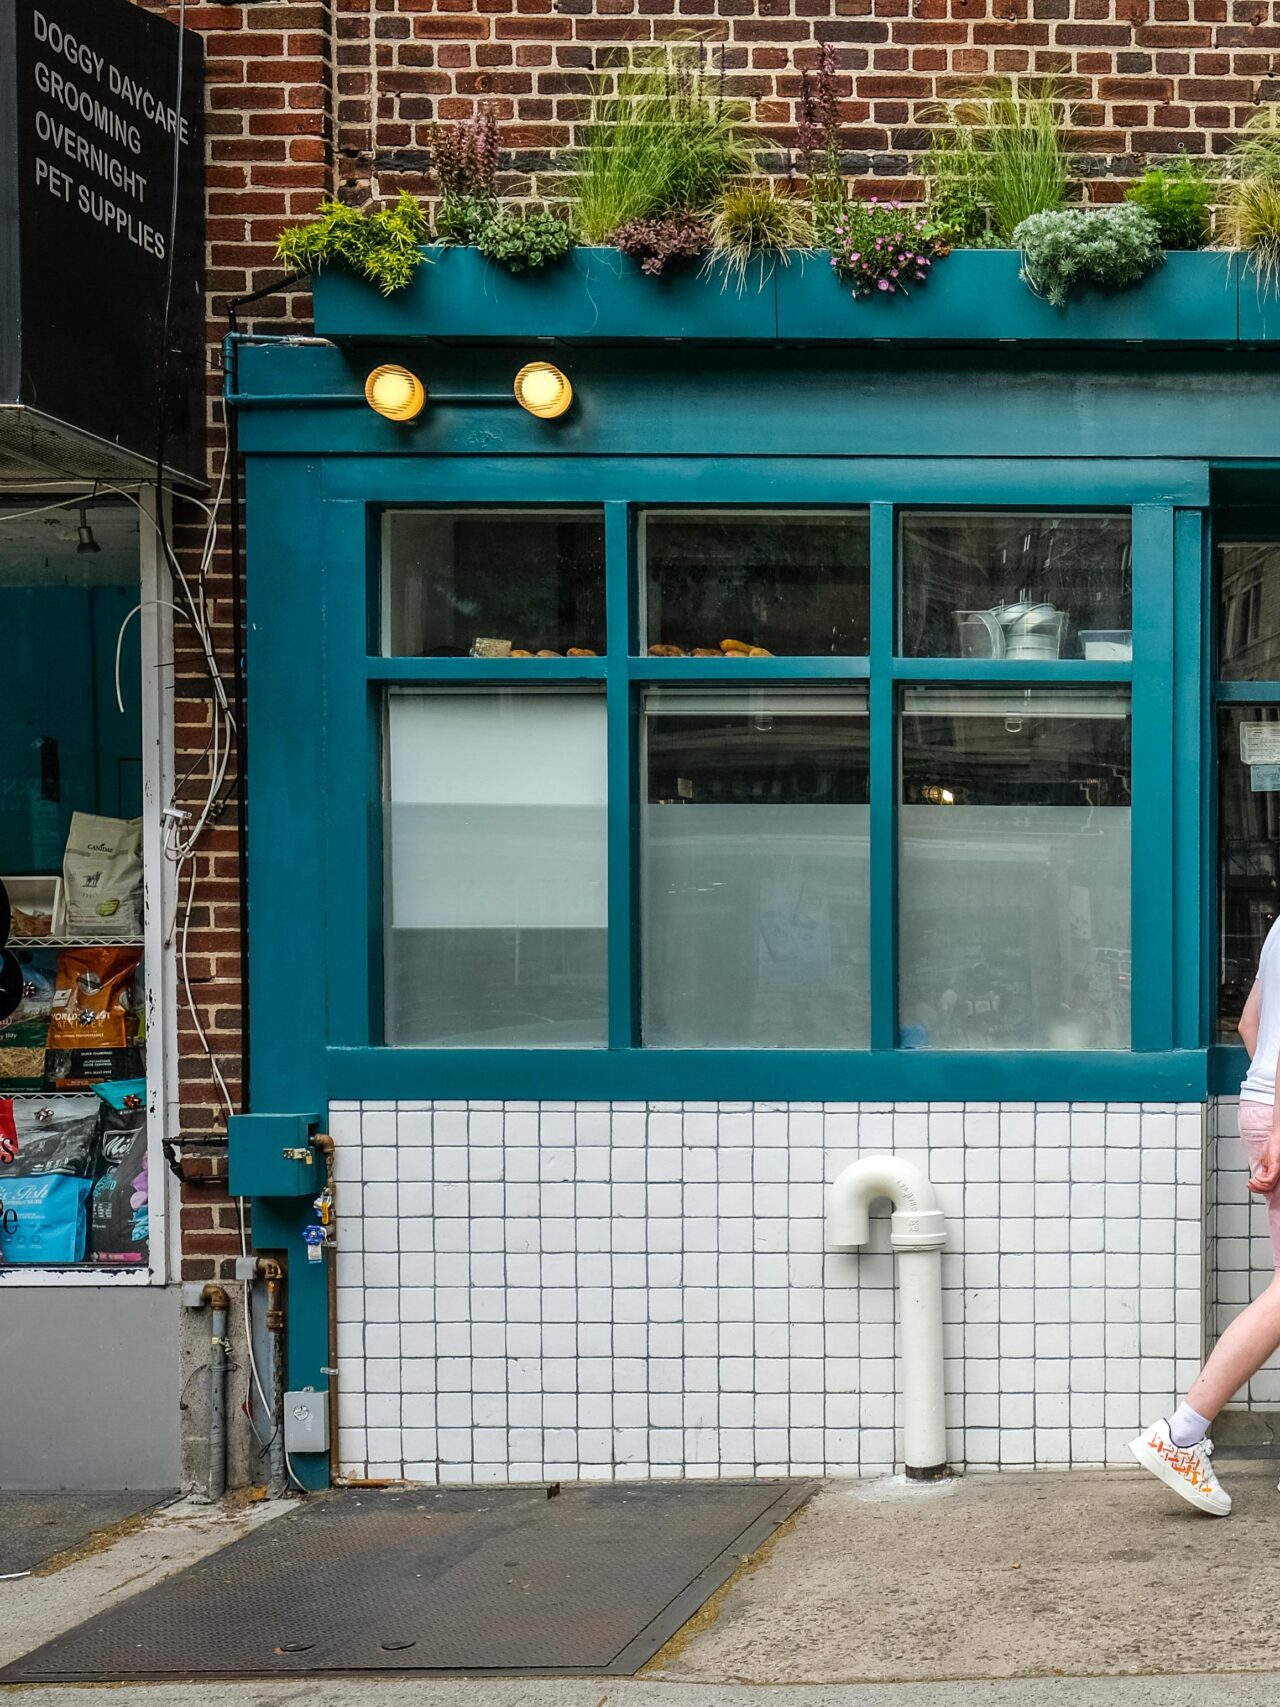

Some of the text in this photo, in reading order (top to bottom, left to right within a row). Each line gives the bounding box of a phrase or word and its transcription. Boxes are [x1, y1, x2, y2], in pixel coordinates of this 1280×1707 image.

[34, 10, 189, 145] DOGGY DAYCARE
[35, 62, 141, 154] GROOMING
[36, 111, 147, 202] OVERNIGHT
[36, 157, 165, 260] PET SUPPLIES
